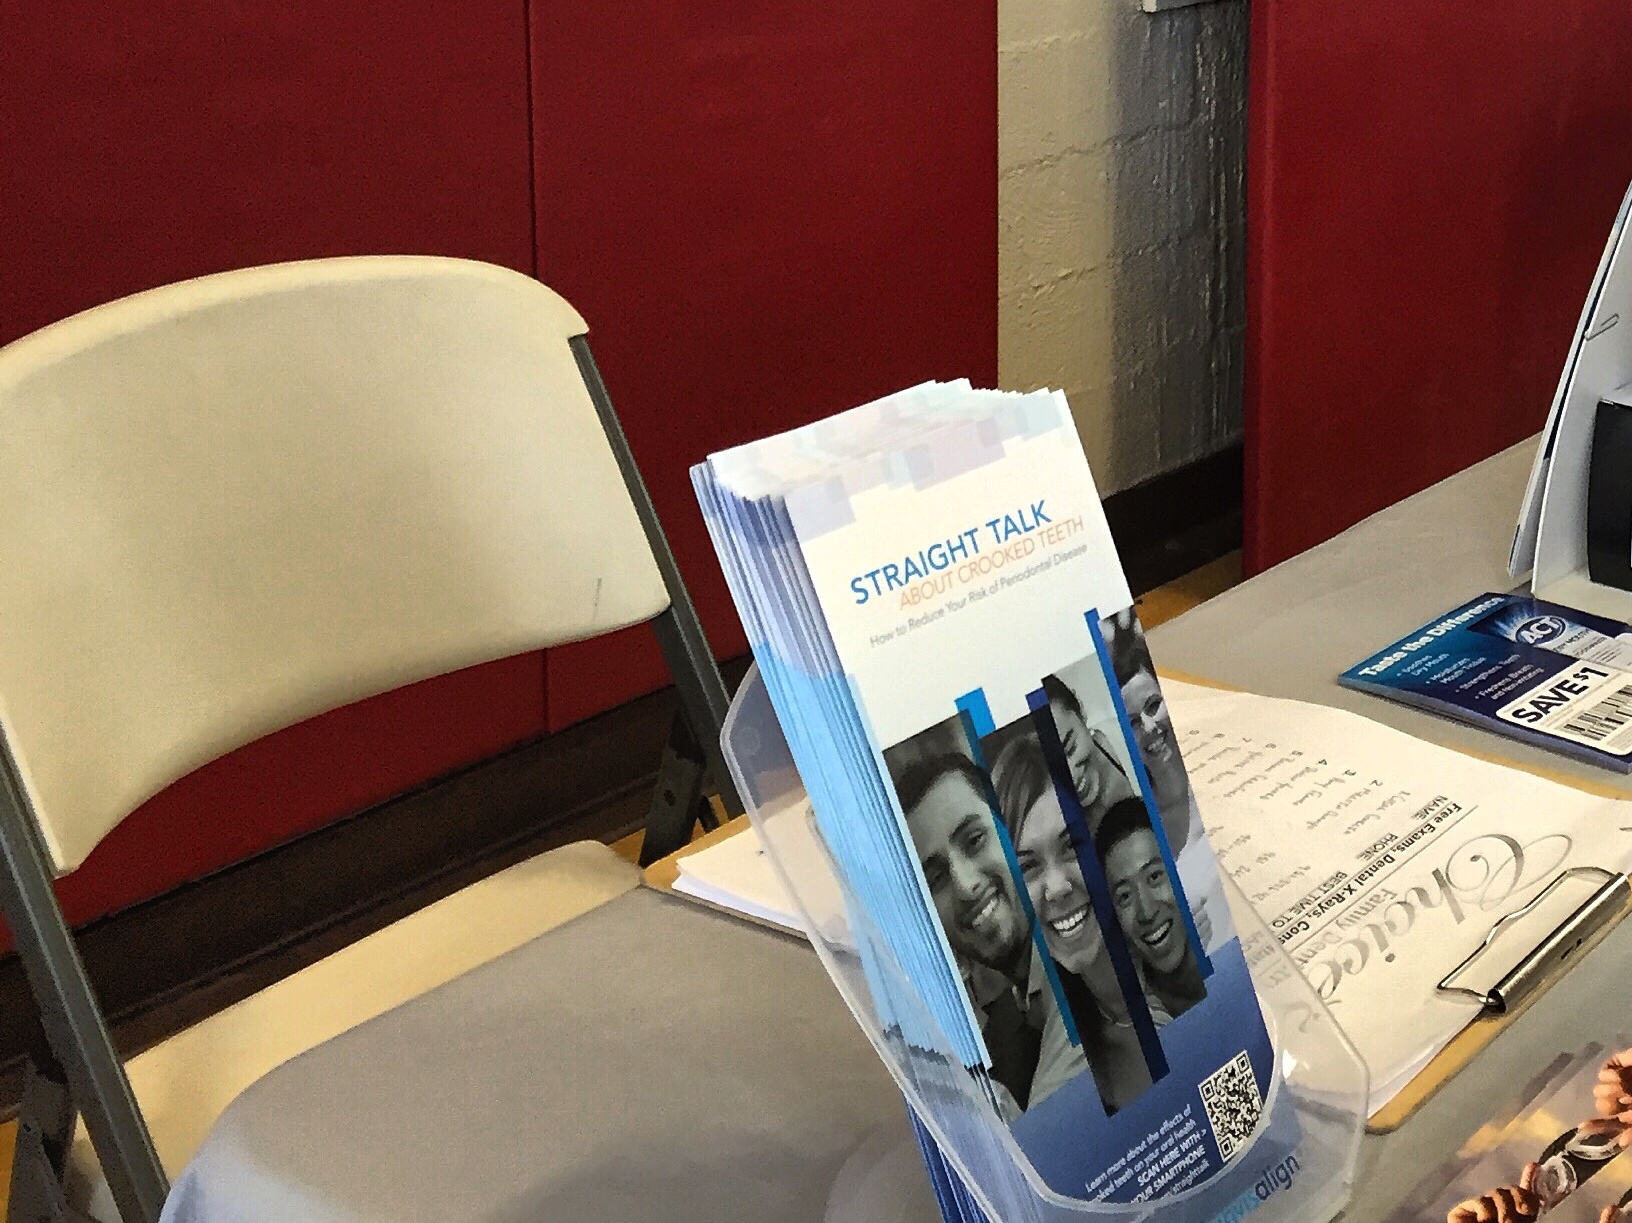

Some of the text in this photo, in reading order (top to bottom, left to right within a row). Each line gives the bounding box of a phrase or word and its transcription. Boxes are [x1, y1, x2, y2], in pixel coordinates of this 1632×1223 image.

[850, 499, 1053, 605] STRAIGHT TALK
[900, 515, 1085, 611] ABOUT CROOKED TEETH
[870, 543, 1088, 648] How to Reduce Your Risk of Periodontal Disease
[1358, 596, 1506, 678] Taste the Difference
[1520, 615, 1562, 646] ACT
[1511, 665, 1610, 724] SAVE $1
[1432, 800, 1464, 825] Free
[1389, 822, 1437, 855] Exams,
[1320, 869, 1349, 897] BEST
[1354, 852, 1397, 887] Dental
[1270, 913, 1293, 929] TO
[1287, 890, 1322, 916] TIME
[1306, 882, 1359, 920] X-Rays,
[1315, 831, 1574, 1008] Choice
[1335, 887, 1398, 932] Family
[1085, 1103, 1193, 1194] Learn more about the effects of
[1114, 1117, 1197, 1188] teeth on your oral health
[1137, 1131, 1201, 1188] SCAN HERE WITH
[1152, 1144, 1207, 1193] SMARTPHONE
